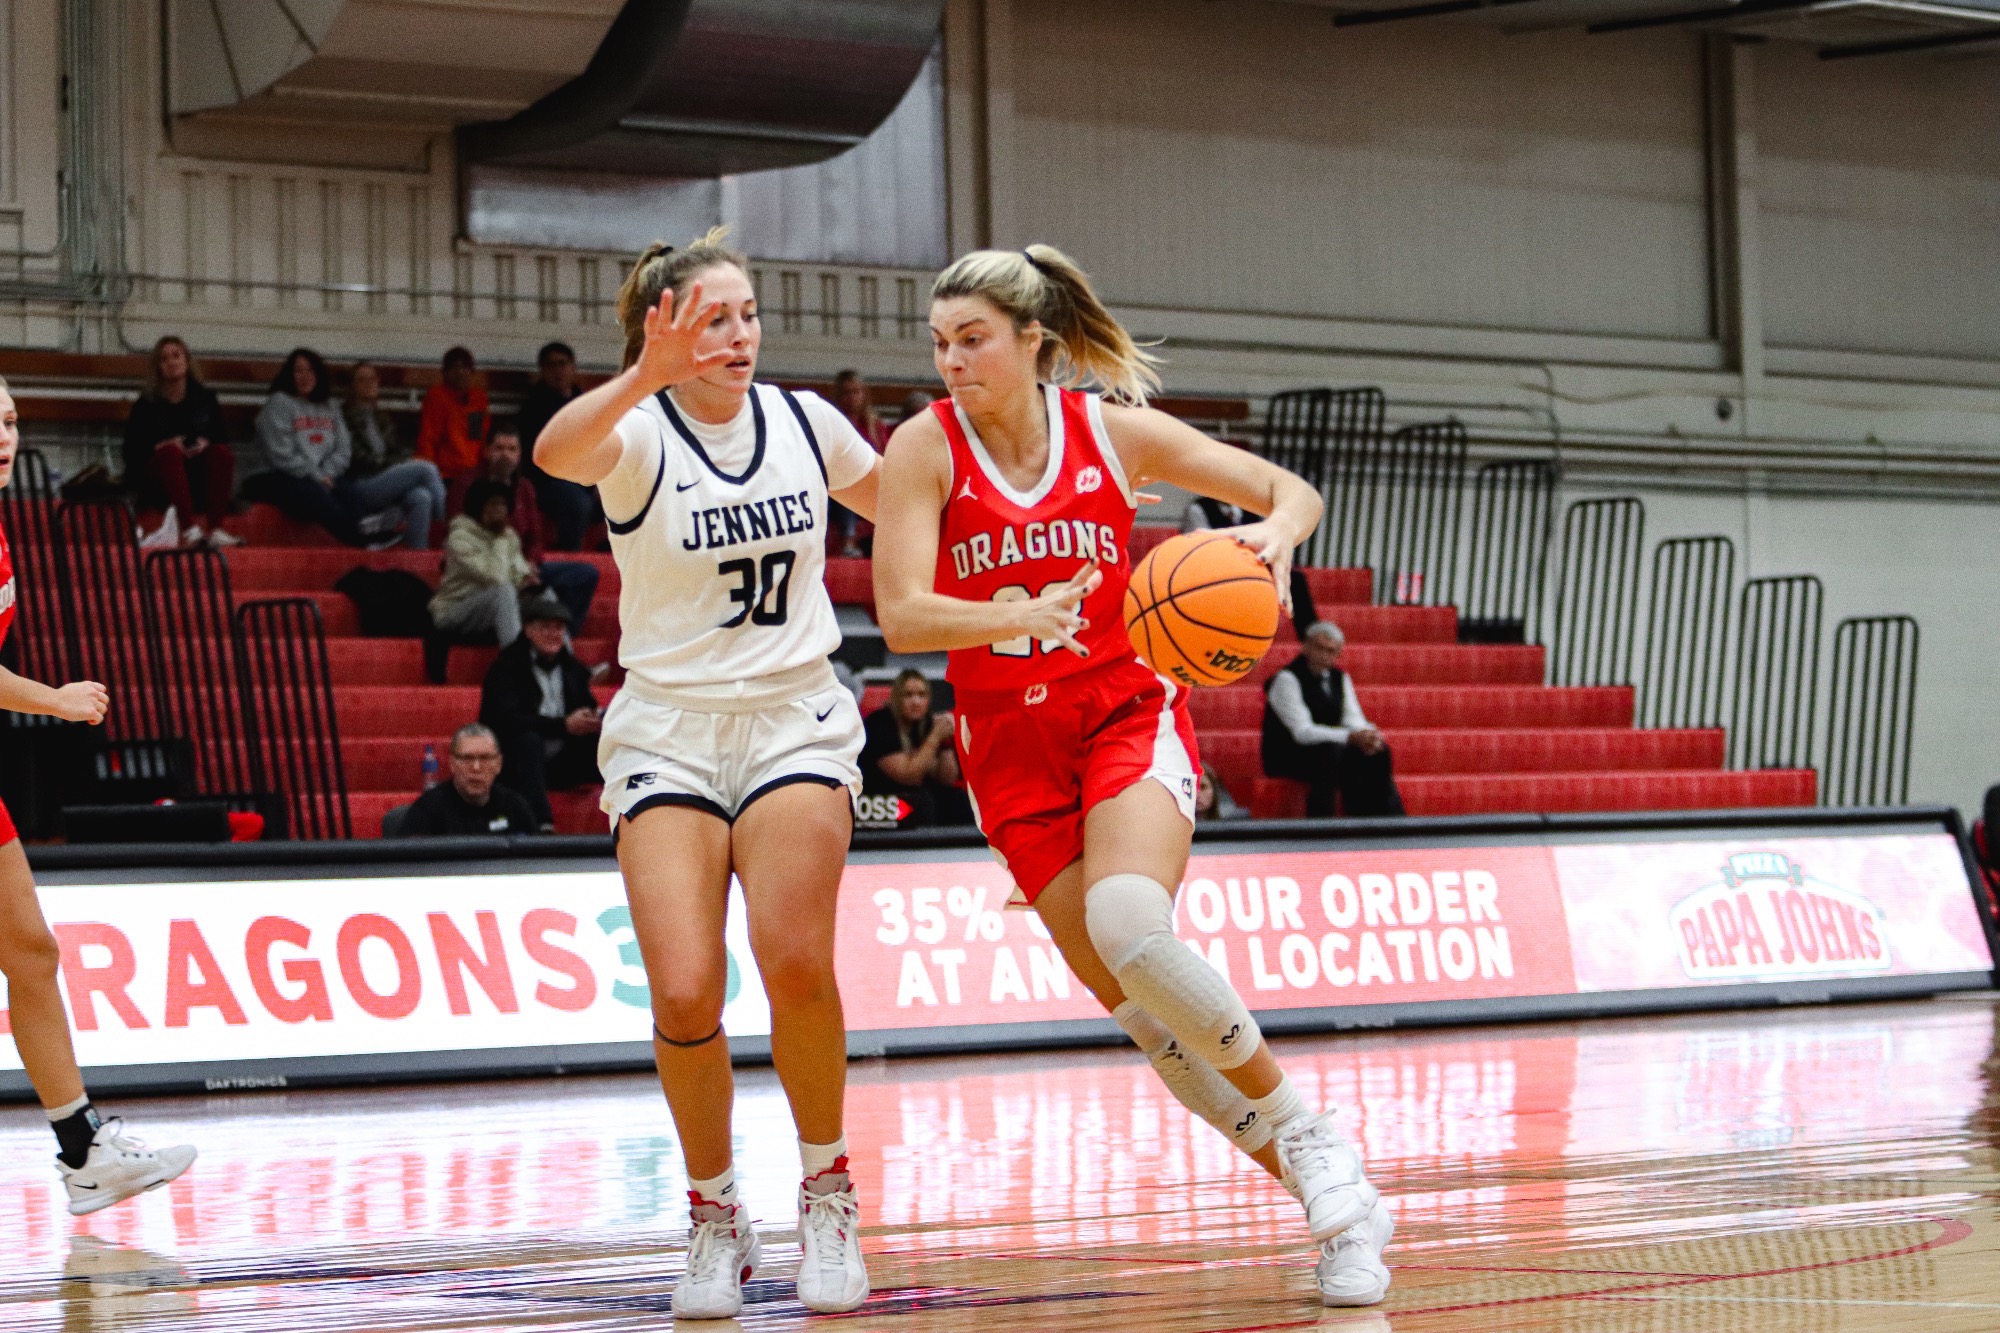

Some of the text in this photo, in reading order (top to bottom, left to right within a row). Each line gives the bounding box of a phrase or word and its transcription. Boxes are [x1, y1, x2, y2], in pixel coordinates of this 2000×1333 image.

[683, 490, 814, 551] JENNIES
[951, 519, 1119, 580] DRAGONS
[718, 550, 796, 628] 30
[856, 794, 898, 820] OSS
[873, 886, 1005, 945] 35%
[1320, 869, 1503, 929] ORDER
[1680, 889, 1882, 968] PAPA JOHNS
[896, 948, 967, 1008] AT
[989, 945, 1096, 1004] AN
[1248, 926, 1514, 991] LOCATION
